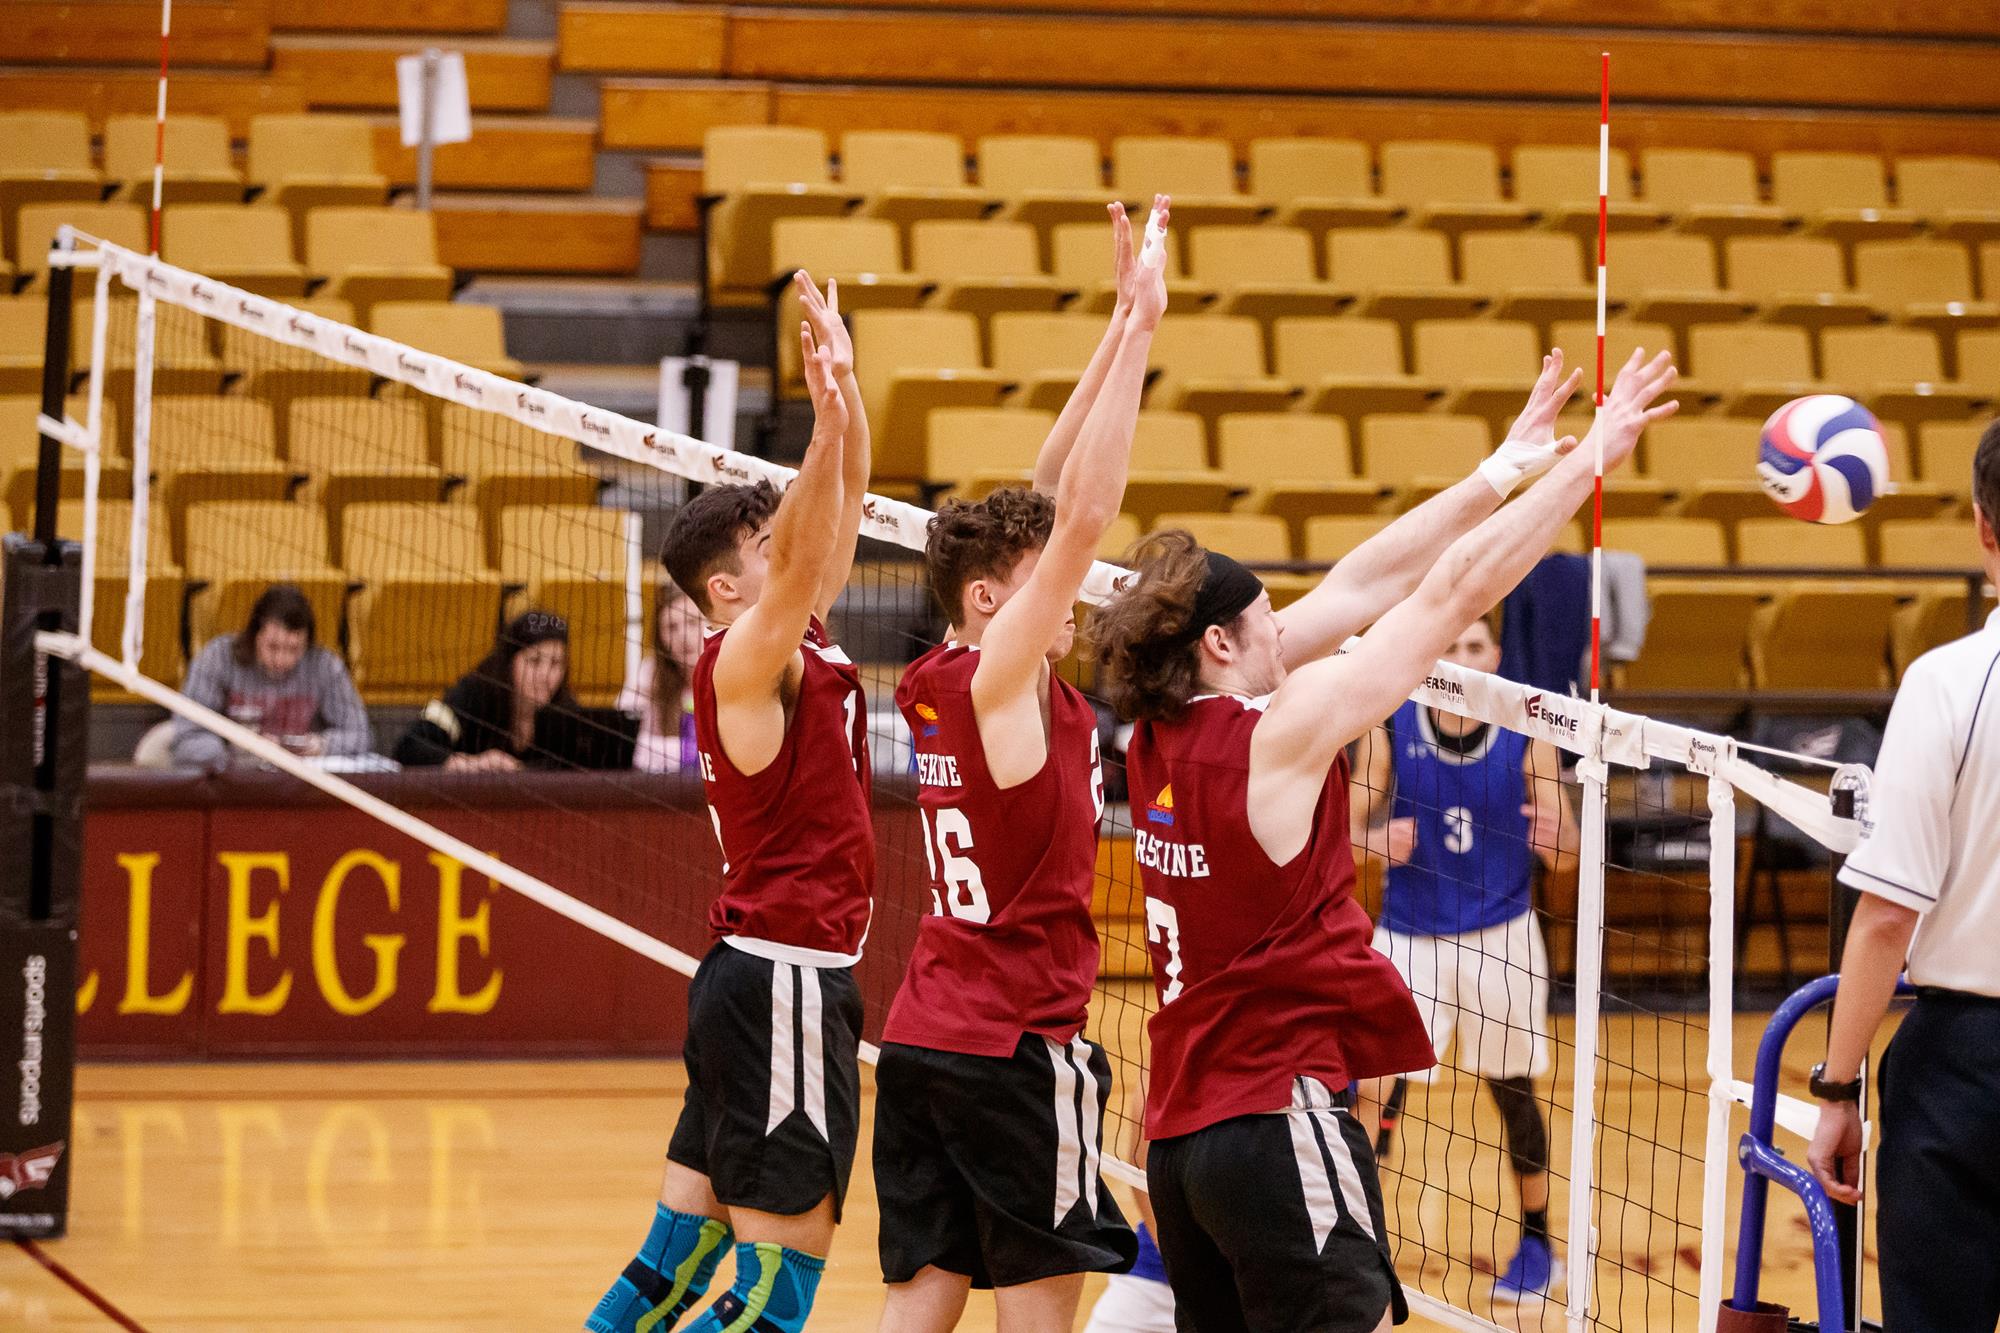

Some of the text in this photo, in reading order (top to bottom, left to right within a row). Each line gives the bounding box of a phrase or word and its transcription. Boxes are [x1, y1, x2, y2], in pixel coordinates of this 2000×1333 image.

[1443, 806, 1474, 854] 3
[76, 848, 503, 1016] LEGE
[1145, 896, 1184, 1006] 7
